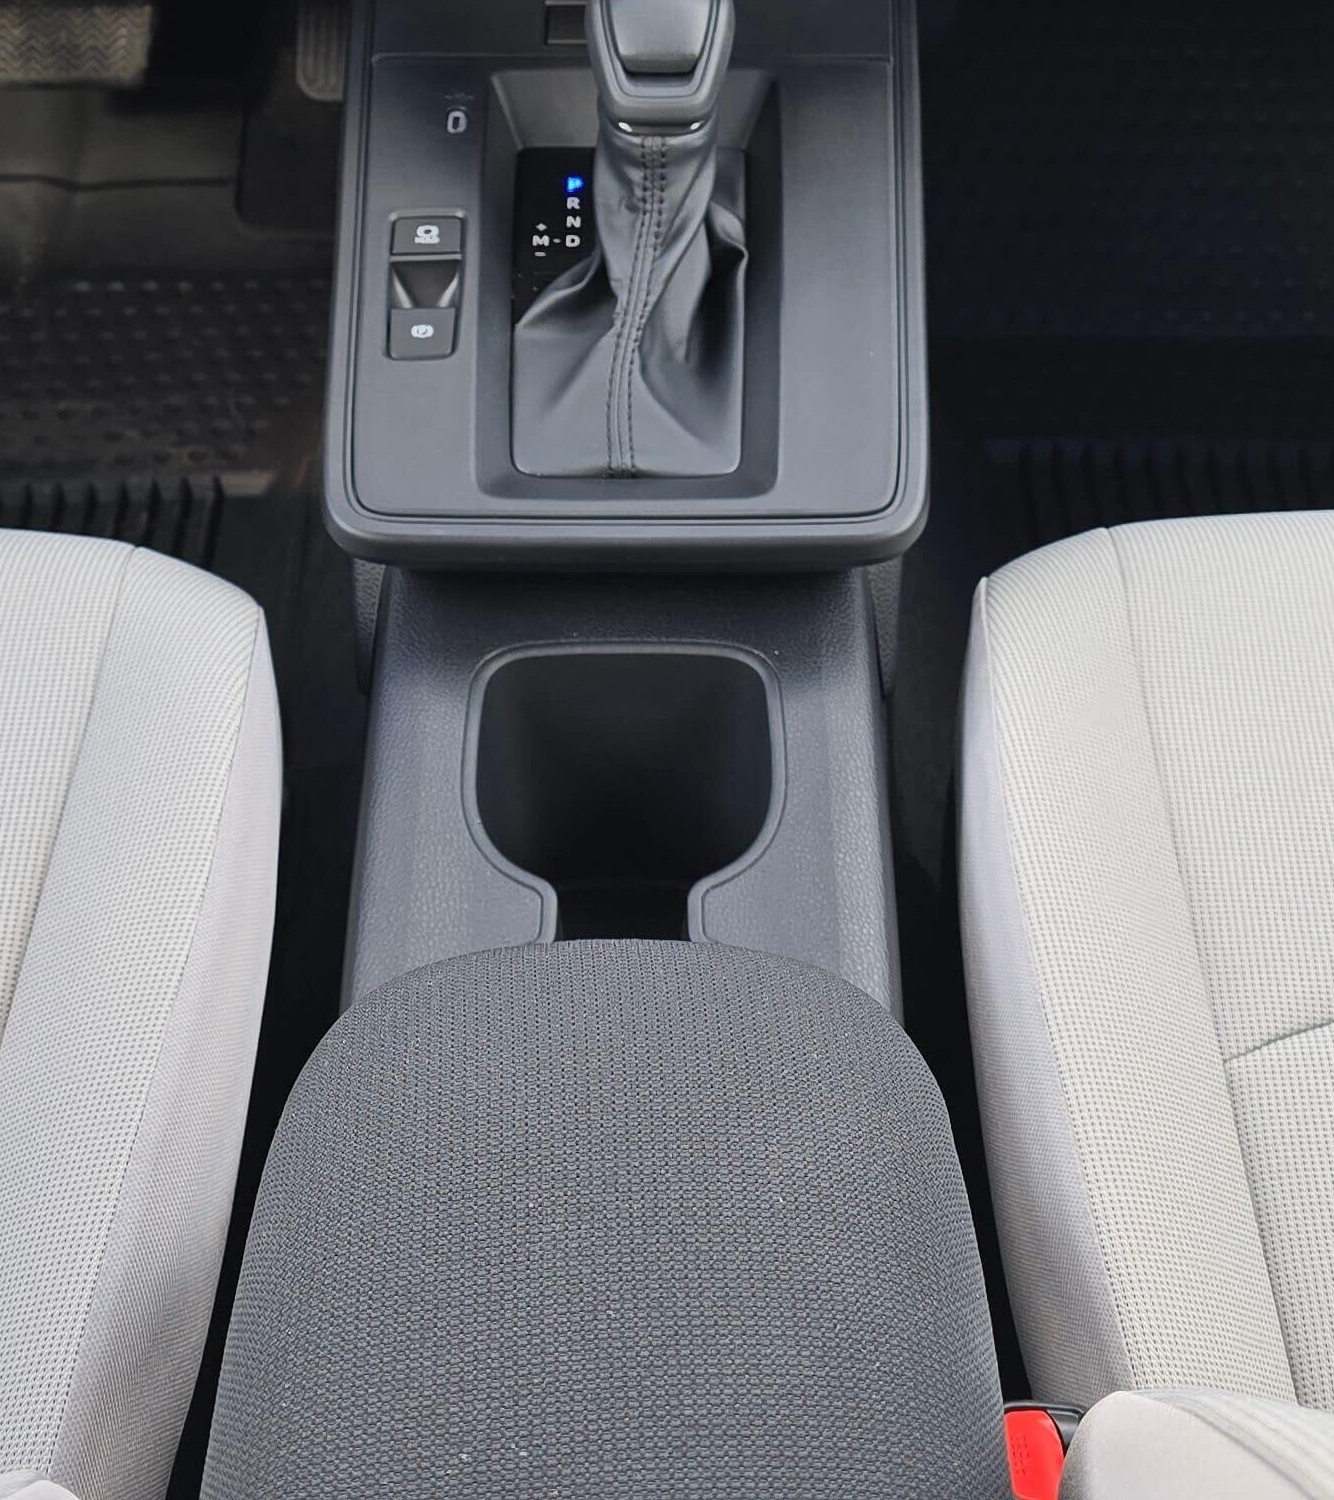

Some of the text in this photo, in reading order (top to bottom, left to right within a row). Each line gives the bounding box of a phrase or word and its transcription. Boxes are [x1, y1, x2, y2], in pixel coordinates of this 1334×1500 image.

[566, 196, 581, 210] R
[566, 215, 582, 228] N
[532, 235, 550, 247] M
[565, 234, 581, 248] D
